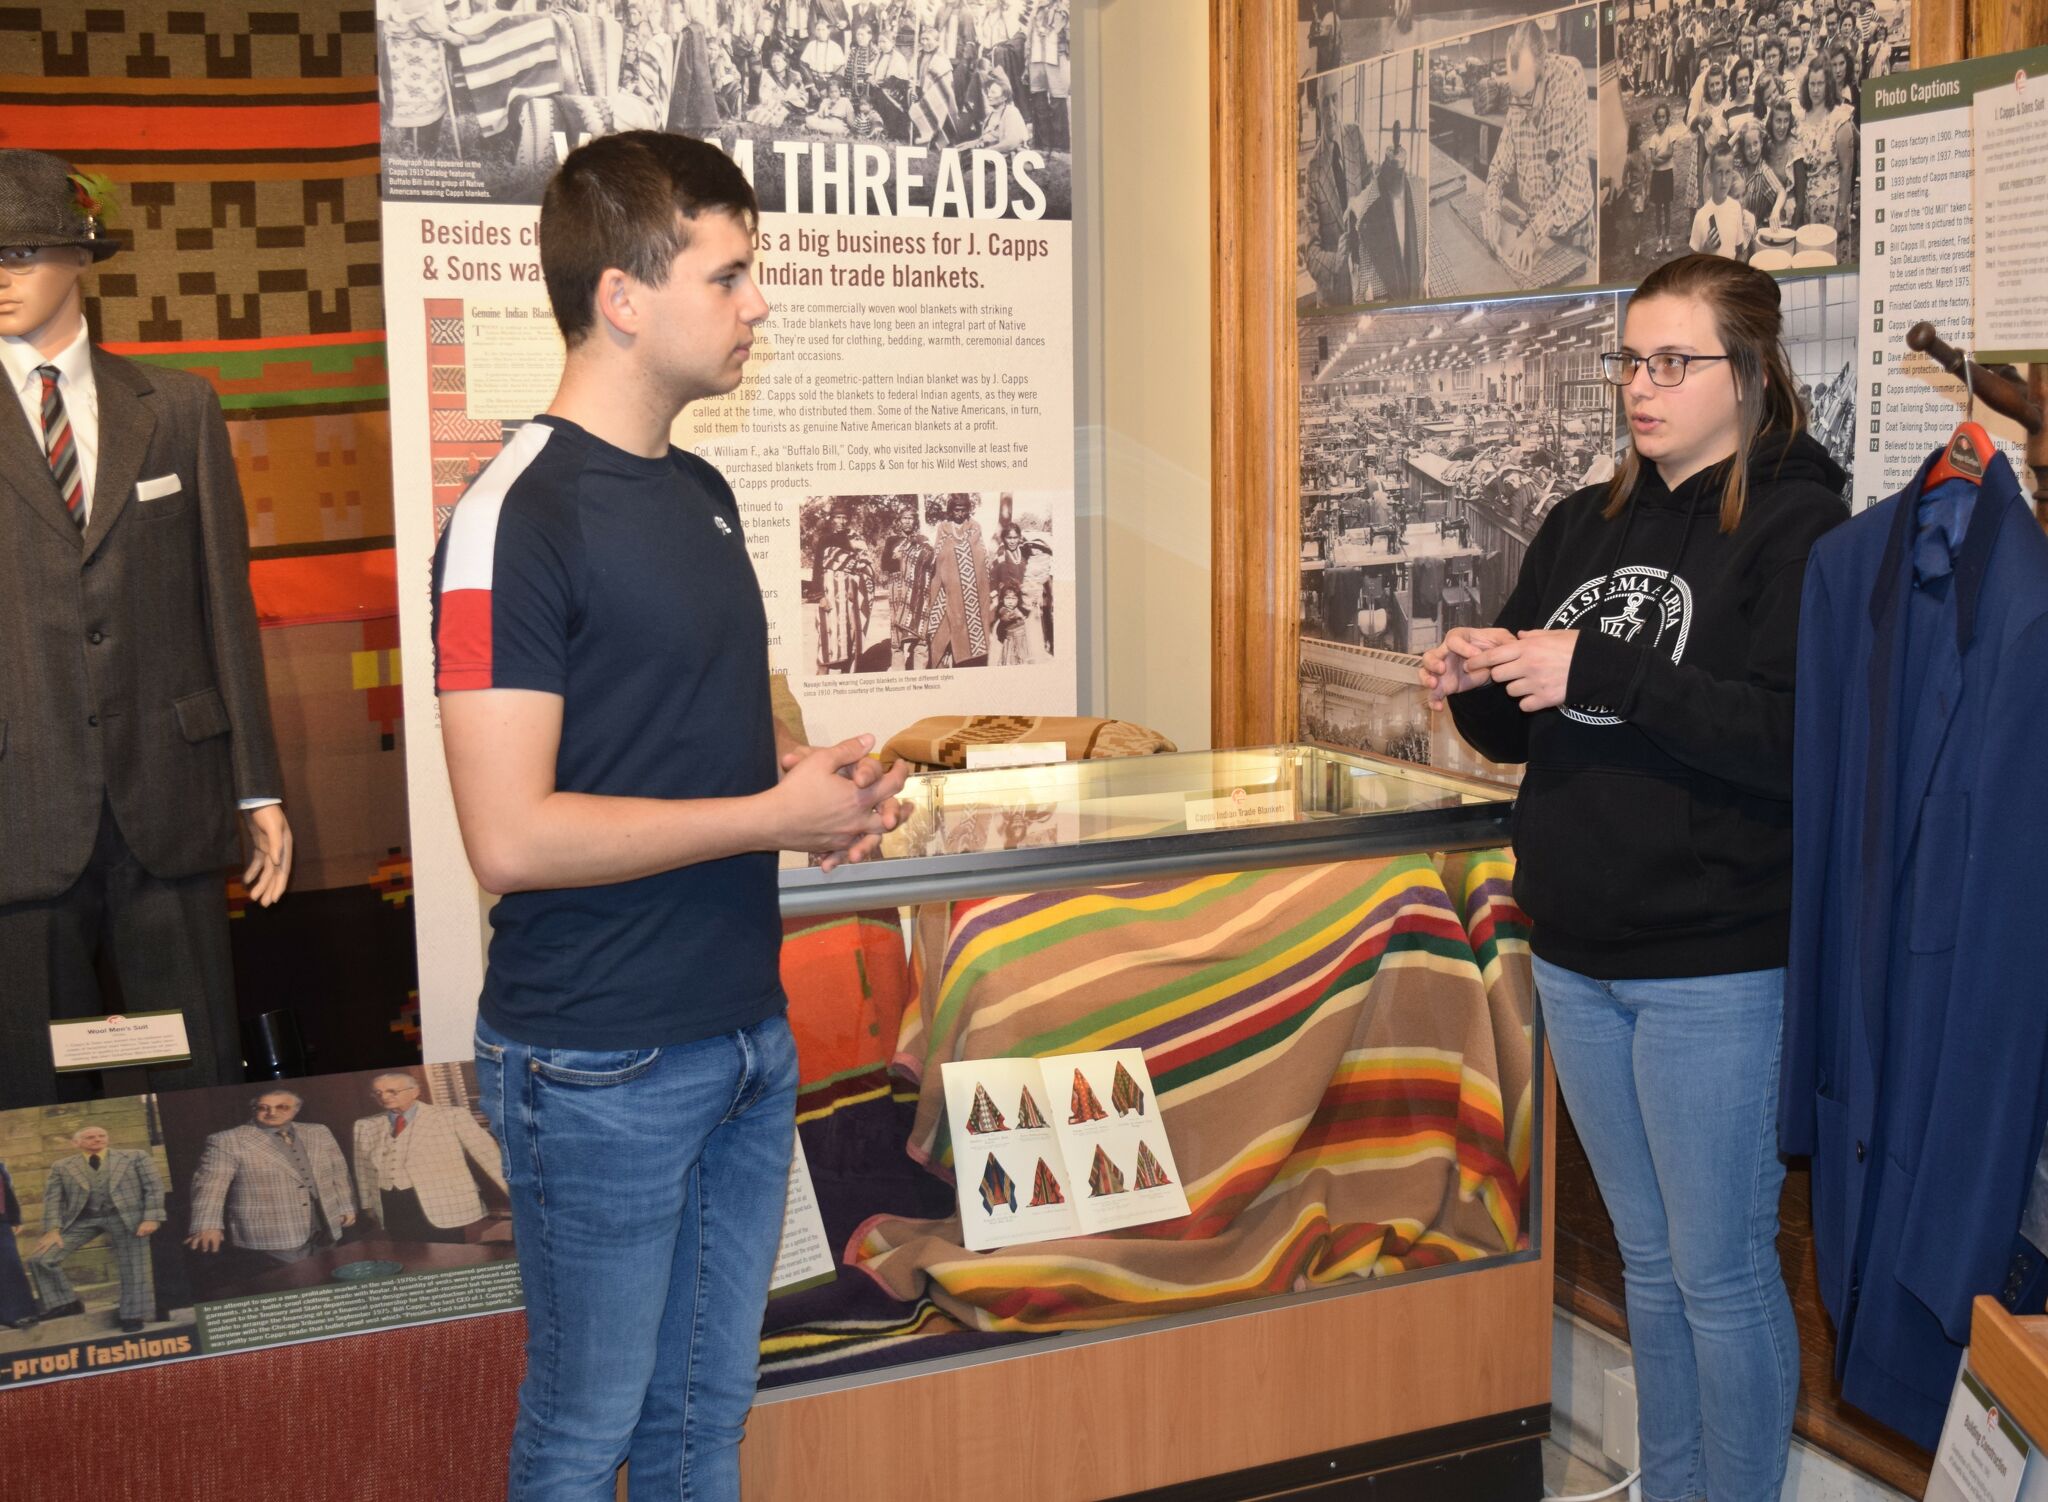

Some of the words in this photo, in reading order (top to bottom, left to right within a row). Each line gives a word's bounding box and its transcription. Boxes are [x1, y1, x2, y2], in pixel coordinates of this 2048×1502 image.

[1875, 88, 1907, 108] Photo
[1910, 79, 1960, 102] Captions
[1890, 137, 1908, 149] Capps
[1908, 134, 1928, 146] factory
[1937, 130, 1953, 142] 1900.
[1954, 127, 1972, 139] Photo
[1890, 156, 1908, 169] Capps
[1909, 154, 1928, 165] factory
[1929, 154, 1935, 162] in
[1936, 150, 1952, 161] 1937.
[1954, 147, 1972, 159] Photo
[773, 141, 1047, 221] THREADS
[421, 219, 511, 246] Besides
[779, 233, 790, 251] a
[799, 229, 830, 257] big
[837, 230, 926, 255] business
[932, 231, 962, 255] for
[967, 232, 981, 256] J.
[988, 232, 1049, 261] Capps
[423, 256, 438, 281] &
[447, 256, 502, 282] Sons
[510, 263, 542, 282] wa
[758, 261, 823, 286] Indian
[830, 264, 885, 287] trade
[892, 264, 985, 289] blankets.
[505, 307, 528, 319] Indian
[790, 304, 804, 312] are
[806, 302, 866, 313] commercially
[868, 305, 895, 313] woven
[897, 303, 917, 313] wool
[919, 303, 957, 314] blankets
[959, 304, 978, 314] with
[980, 304, 1013, 316] striking
[782, 317, 806, 328] Trade
[808, 318, 847, 328] blankets
[849, 319, 871, 329] have
[873, 319, 892, 331] long
[894, 320, 916, 329] been
[918, 321, 929, 329] an
[931, 319, 965, 332] integral
[967, 321, 985, 331] part
[987, 319, 996, 330] of
[998, 319, 1026, 330] Native
[774, 333, 805, 344] They're
[807, 334, 829, 344] used
[832, 334, 844, 344] for
[846, 334, 884, 347] clothing,
[887, 334, 925, 347] bedding,
[927, 335, 962, 345] warmth,
[965, 337, 1012, 345] ceremonial
[1014, 337, 1045, 345] dances
[750, 351, 794, 360] important
[797, 352, 843, 360] occasions.
[1886, 403, 1899, 412] Coat
[1900, 402, 1923, 414] Tailoring
[1924, 402, 1939, 412] Shop
[1939, 404, 1954, 412] circa
[693, 422, 712, 433] sold
[714, 422, 738, 432] them
[740, 422, 750, 432] to
[752, 422, 786, 432] tourists
[789, 423, 800, 432] as
[802, 423, 838, 434] genuine
[840, 421, 868, 431] Native
[870, 422, 912, 431] American
[914, 420, 951, 431] blankets
[953, 420, 962, 430] at
[965, 422, 970, 430] a
[973, 419, 997, 430] profit.
[694, 446, 710, 457] Col.
[714, 446, 748, 456] William
[750, 445, 760, 456] F.,
[762, 445, 779, 456] aka
[782, 444, 820, 455] “Buffalo
[822, 444, 844, 455] Bill,”
[846, 443, 870, 455] Cody,
[873, 444, 891, 454] who
[893, 443, 922, 454] visited
[924, 442, 976, 453] Jacksonville
[978, 443, 987, 453] at
[989, 442, 1010, 452] least
[1012, 442, 1028, 452] five
[1556, 603, 1579, 625] PI
[1216, 810, 1237, 820] Indian
[1238, 807, 1256, 817] Trade
[1257, 804, 1285, 815] Blankets
[86, 1335, 193, 1367] fashions
